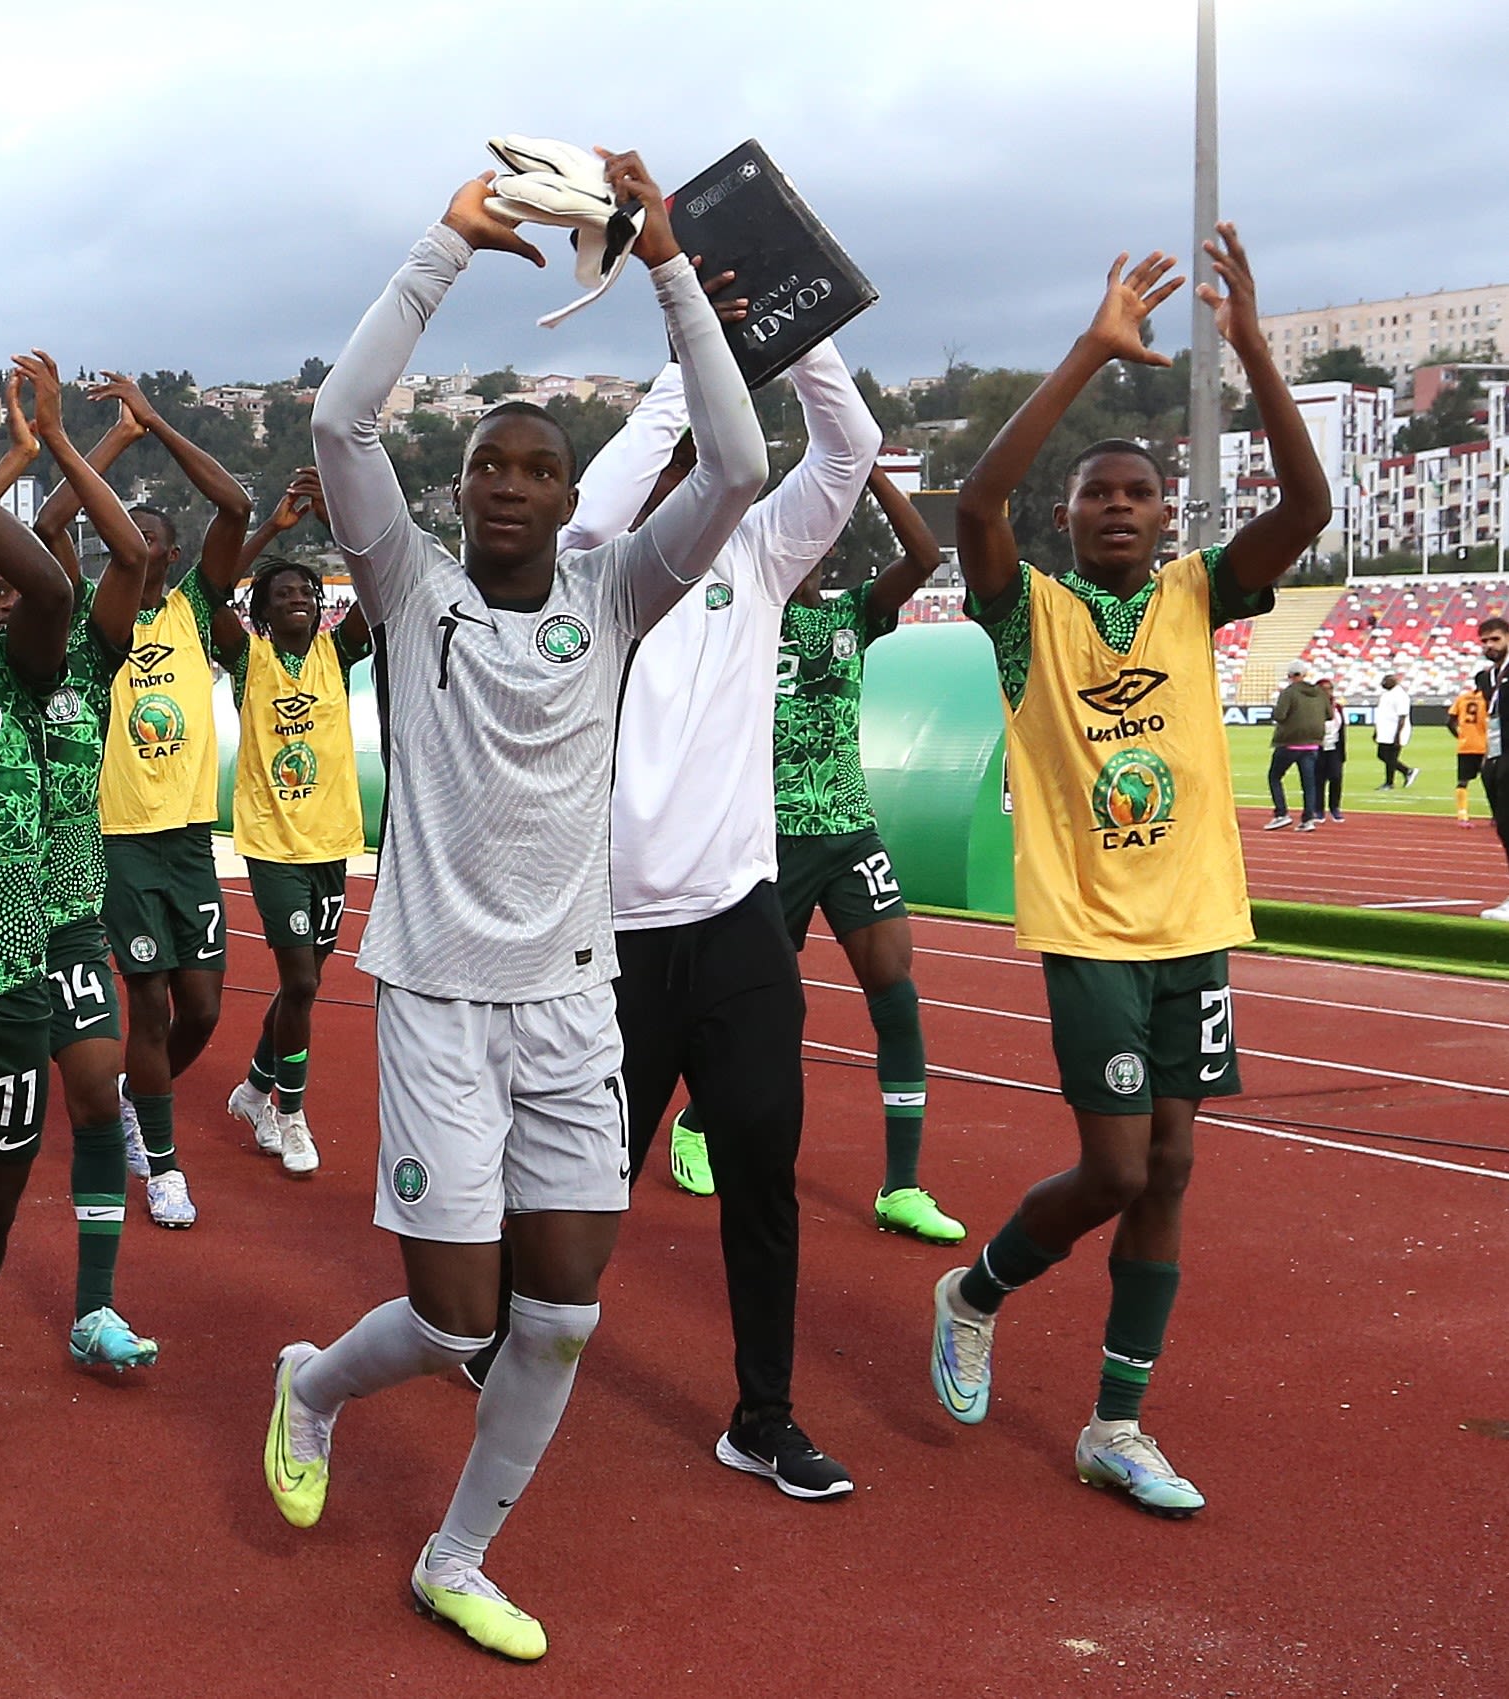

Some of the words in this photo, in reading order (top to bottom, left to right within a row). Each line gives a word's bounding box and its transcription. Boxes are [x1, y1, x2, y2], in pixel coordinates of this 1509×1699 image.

[752, 274, 800, 312] BOARD
[438, 616, 459, 690] 1
[129, 672, 175, 689] mbro
[1464, 701, 1480, 725] 9
[138, 742, 181, 760] CAF
[278, 787, 312, 801] CAF
[1103, 826, 1166, 850] CAF
[853, 851, 900, 896] 12
[198, 902, 221, 944] 7
[319, 894, 346, 931] 17
[48, 963, 106, 1011] 14
[604, 1076, 627, 1148] 1
